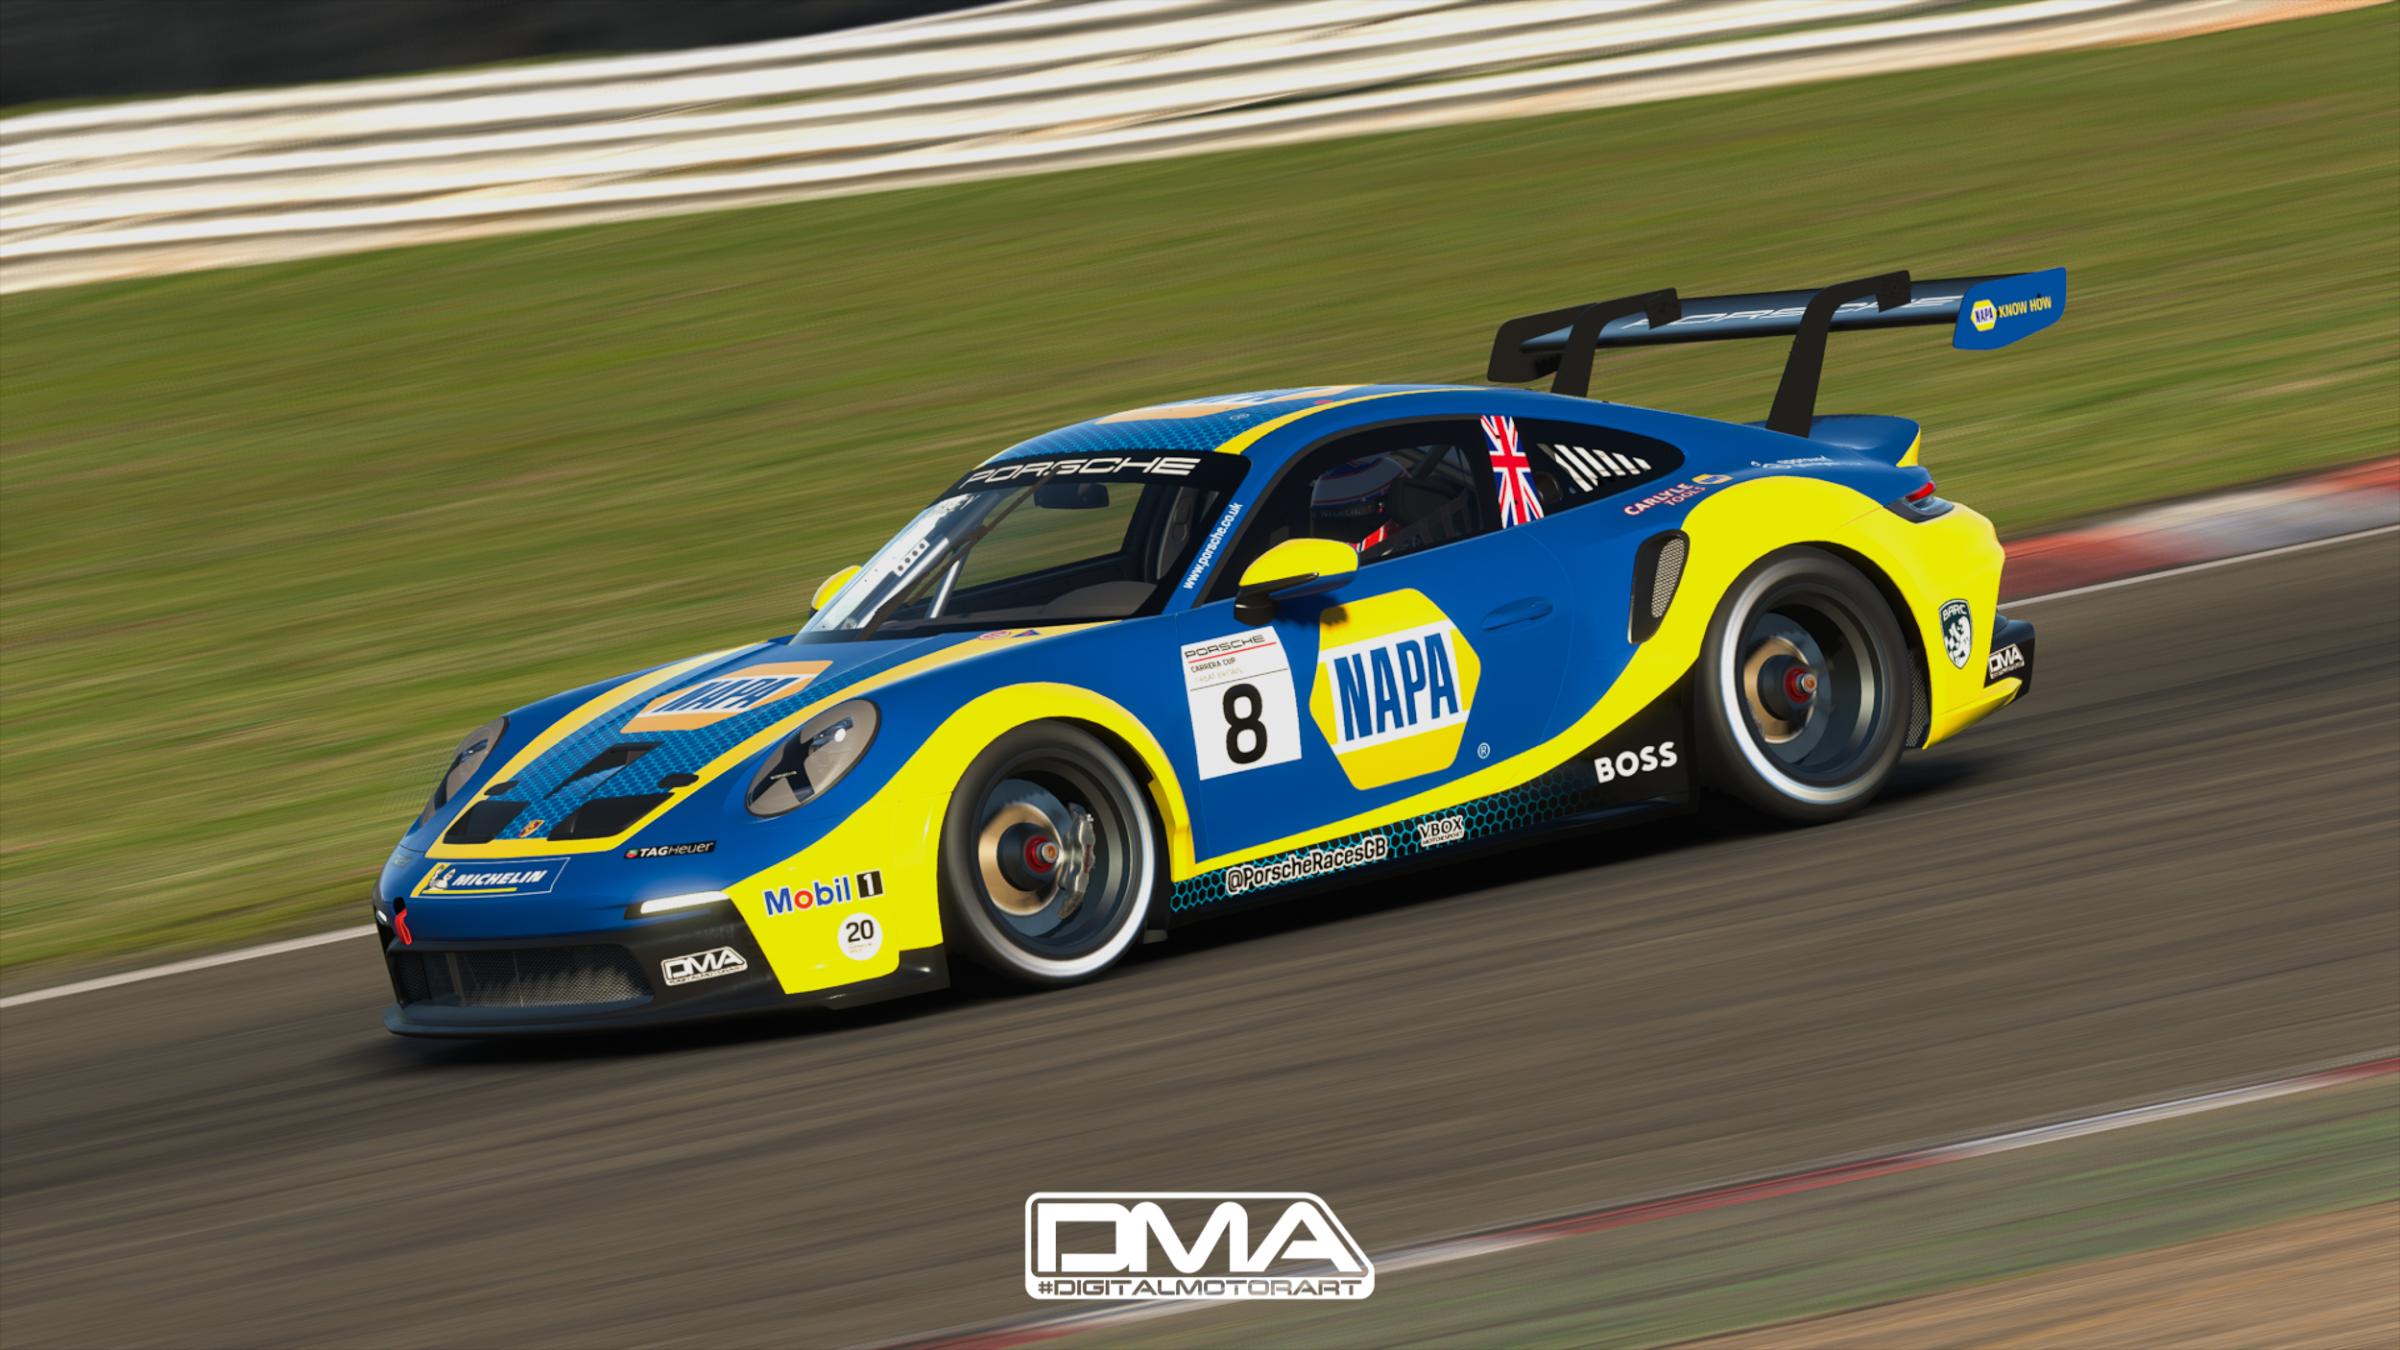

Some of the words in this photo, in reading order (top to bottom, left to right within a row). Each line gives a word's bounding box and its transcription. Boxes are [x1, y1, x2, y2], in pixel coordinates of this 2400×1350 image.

[1974, 307, 1994, 323] NAPA
[1998, 300, 2028, 318] KNOW
[2029, 296, 2052, 312] HOW
[959, 456, 1201, 489] PORSCHE
[1624, 483, 1695, 516] CARLYLE
[1664, 486, 1706, 506] TOOLS
[1183, 502, 1243, 589] www.porsche.co.uk
[1942, 604, 1968, 621] BARC
[1184, 634, 1266, 658] PORSCHE
[1989, 646, 2022, 673] DMA
[1190, 660, 1222, 673] CARRERA
[1222, 657, 1236, 666] CUP
[651, 677, 801, 713] NAPA
[1334, 633, 1459, 742] NAPA
[1222, 683, 1268, 765] 8
[1594, 741, 1678, 784] BOSS
[1419, 817, 1463, 838] VBOX
[452, 870, 548, 886] MICHELIN
[1227, 838, 1388, 892] @PorscheRacesGB
[763, 876, 851, 916] Mobil
[845, 919, 874, 943] 20
[665, 949, 744, 979] DMA
